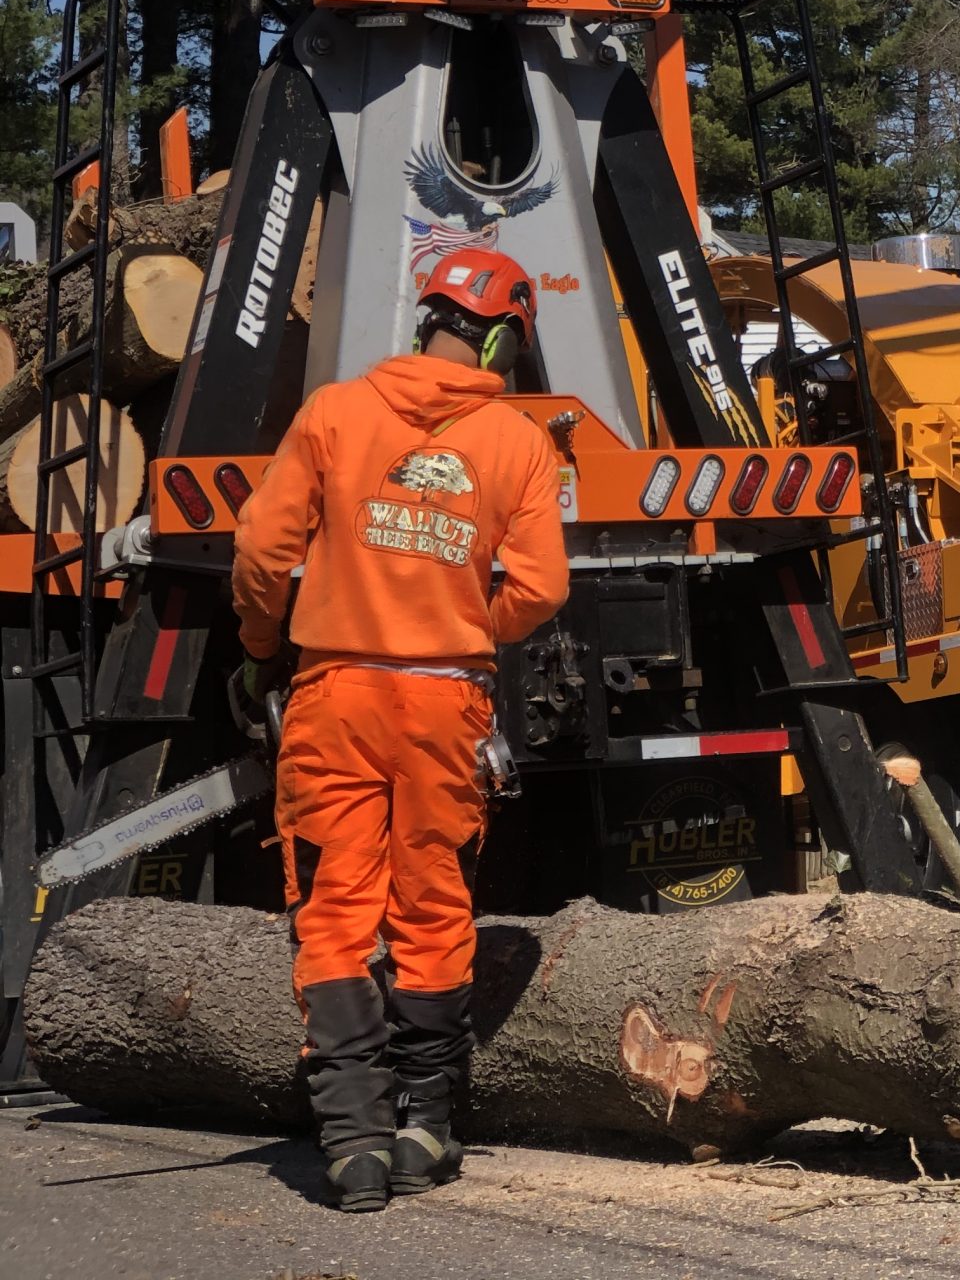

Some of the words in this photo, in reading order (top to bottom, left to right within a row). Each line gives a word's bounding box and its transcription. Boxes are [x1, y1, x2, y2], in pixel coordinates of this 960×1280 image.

[657, 249, 717, 367] ELITE
[705, 363, 733, 412] 915
[115, 802, 189, 843] Husqvarna
